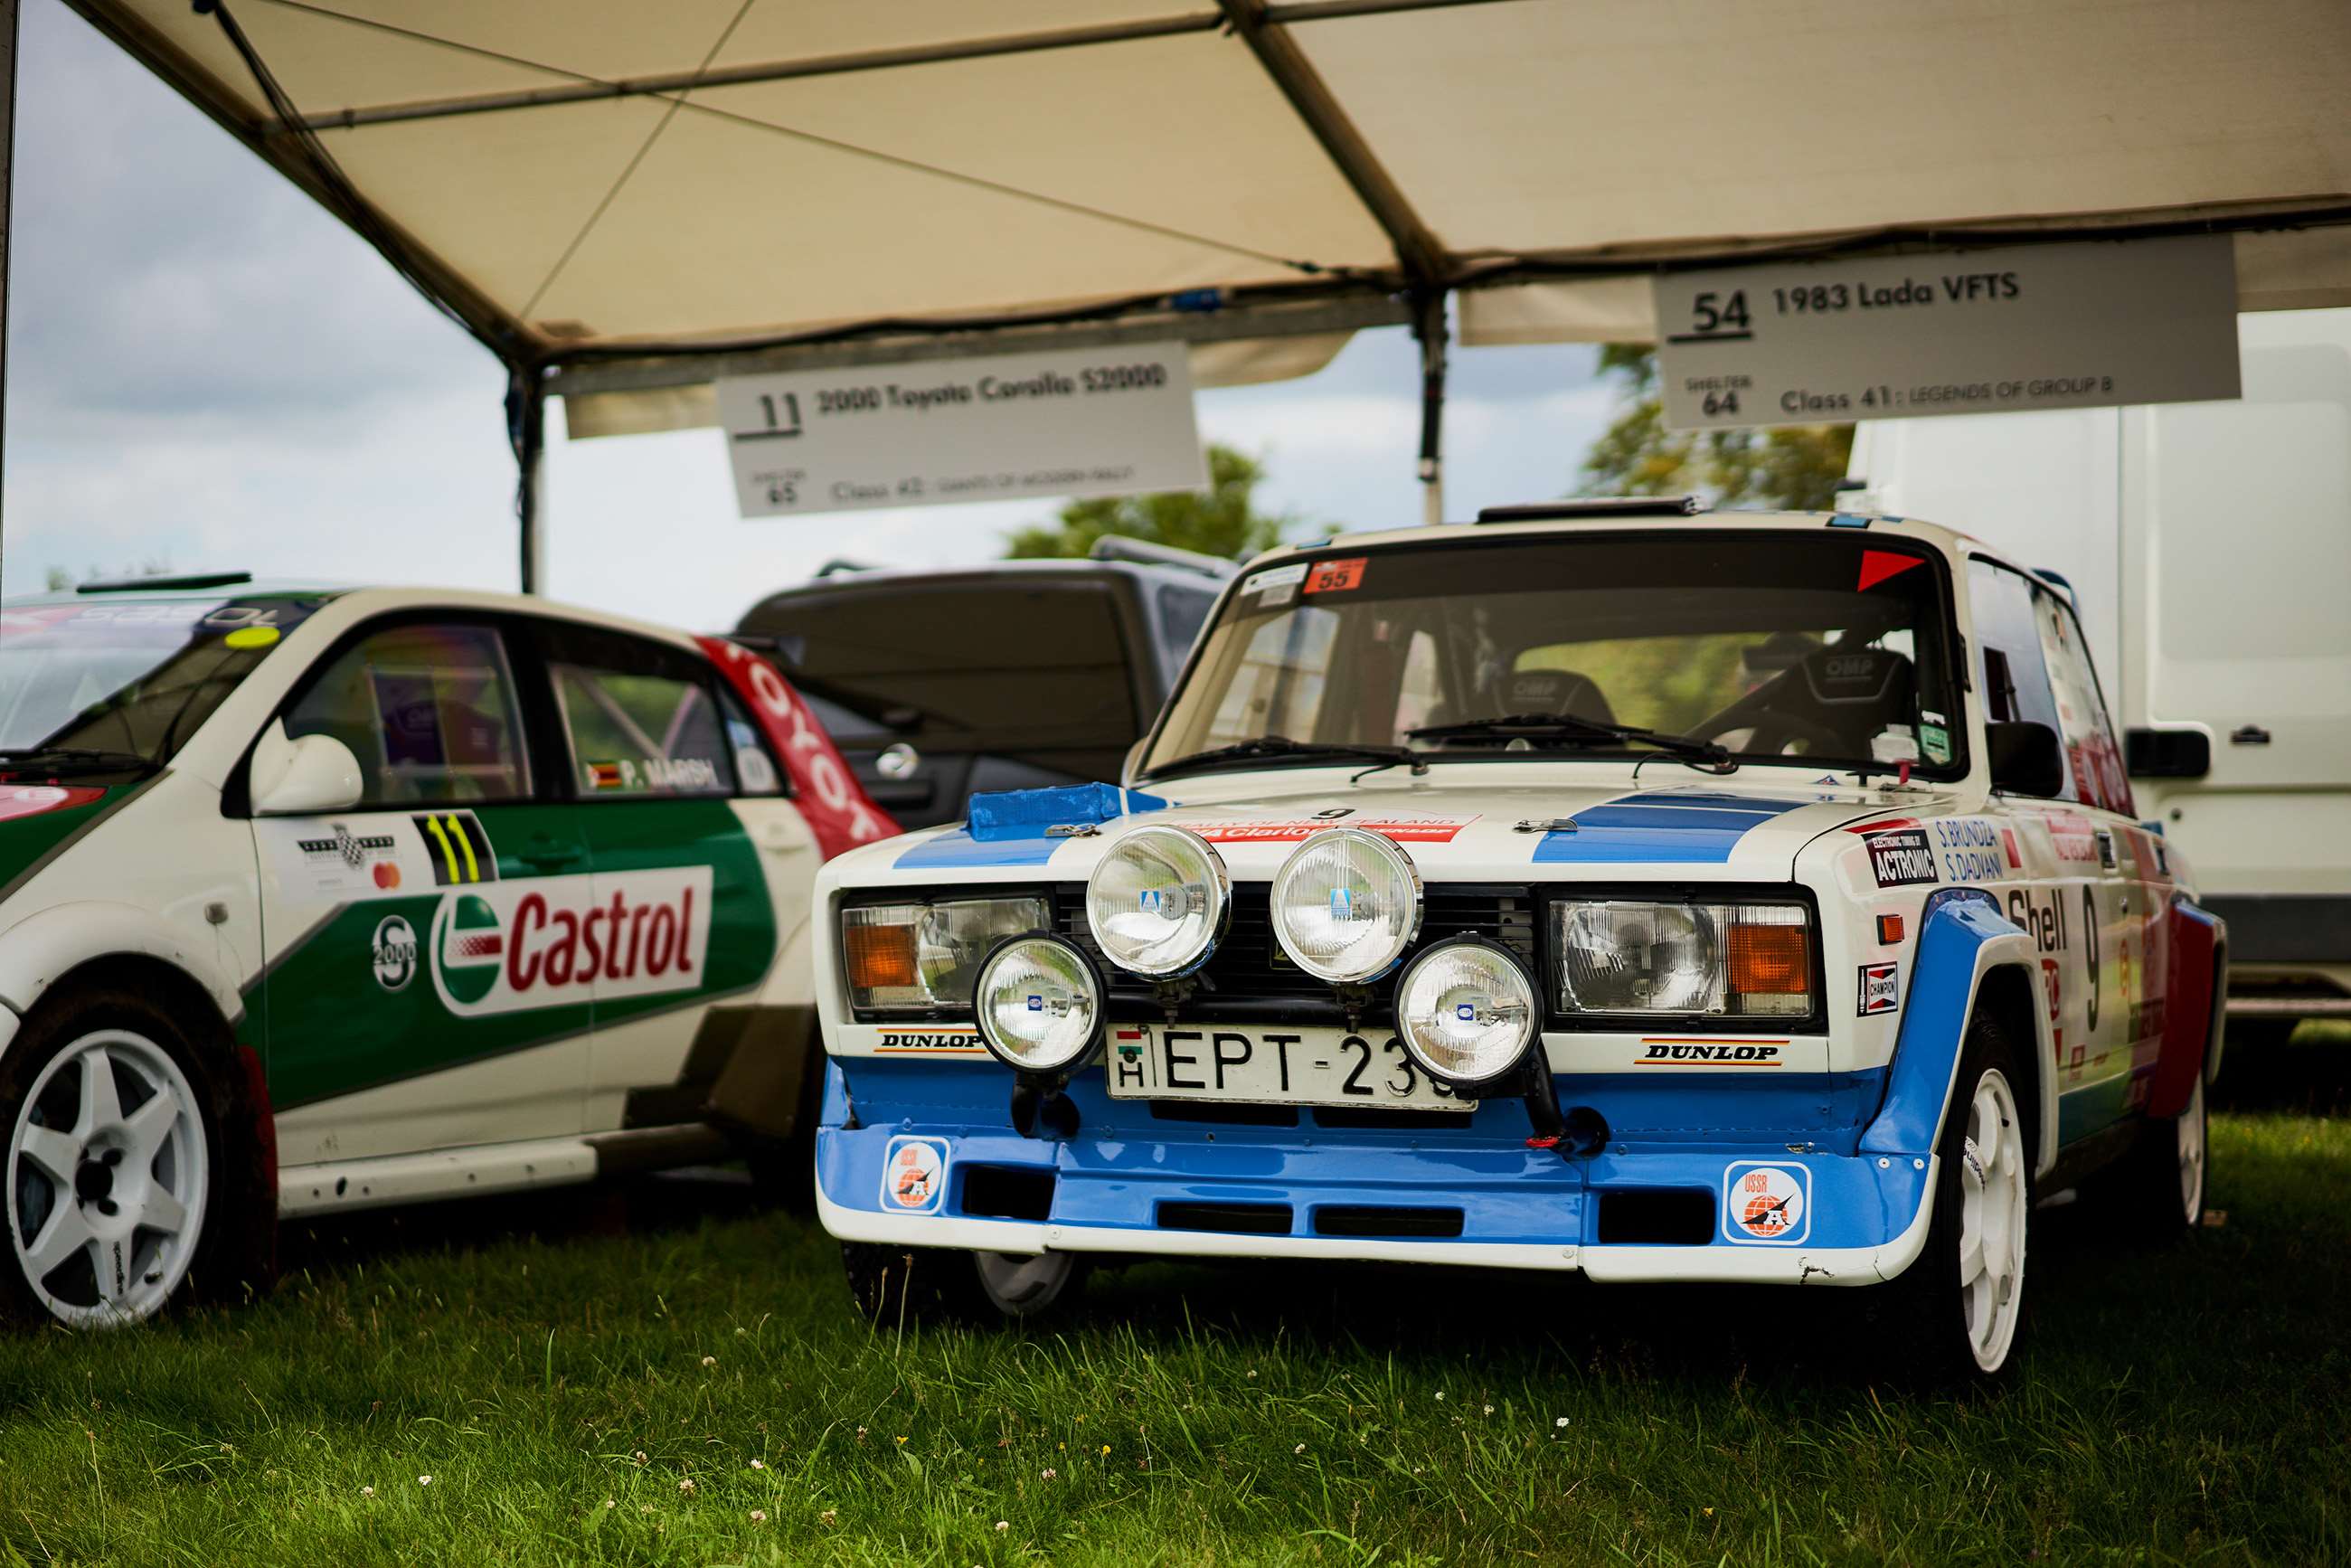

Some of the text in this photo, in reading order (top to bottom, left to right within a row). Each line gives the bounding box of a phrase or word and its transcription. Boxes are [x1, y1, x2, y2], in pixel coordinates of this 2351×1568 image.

[1773, 272, 2019, 314] 1983 Lada VFTS
[1693, 289, 1751, 332] 54
[816, 363, 1167, 415] 2000 Toyota Corolla S2000
[1702, 390, 1741, 418] 64
[1780, 389, 1850, 414] Class
[1909, 383, 1992, 405] LEGENDS
[1995, 381, 2024, 399] OF
[2026, 376, 2097, 397] GROUP
[2101, 375, 2115, 392] B
[760, 392, 802, 428] 11
[1317, 571, 1348, 590] 55
[1310, 808, 1356, 820] 9
[1875, 849, 1935, 882] ACTRONIC
[2007, 889, 2068, 952] Shell
[507, 886, 694, 994] Castrol
[2082, 883, 2101, 1033] 9
[1869, 980, 1895, 997] CHAMPION
[881, 1034, 983, 1048] DUNLOP
[1645, 1044, 1779, 1061] DUNLOP
[1118, 1062, 1144, 1088] H
[1744, 1174, 1768, 1194] USSR
